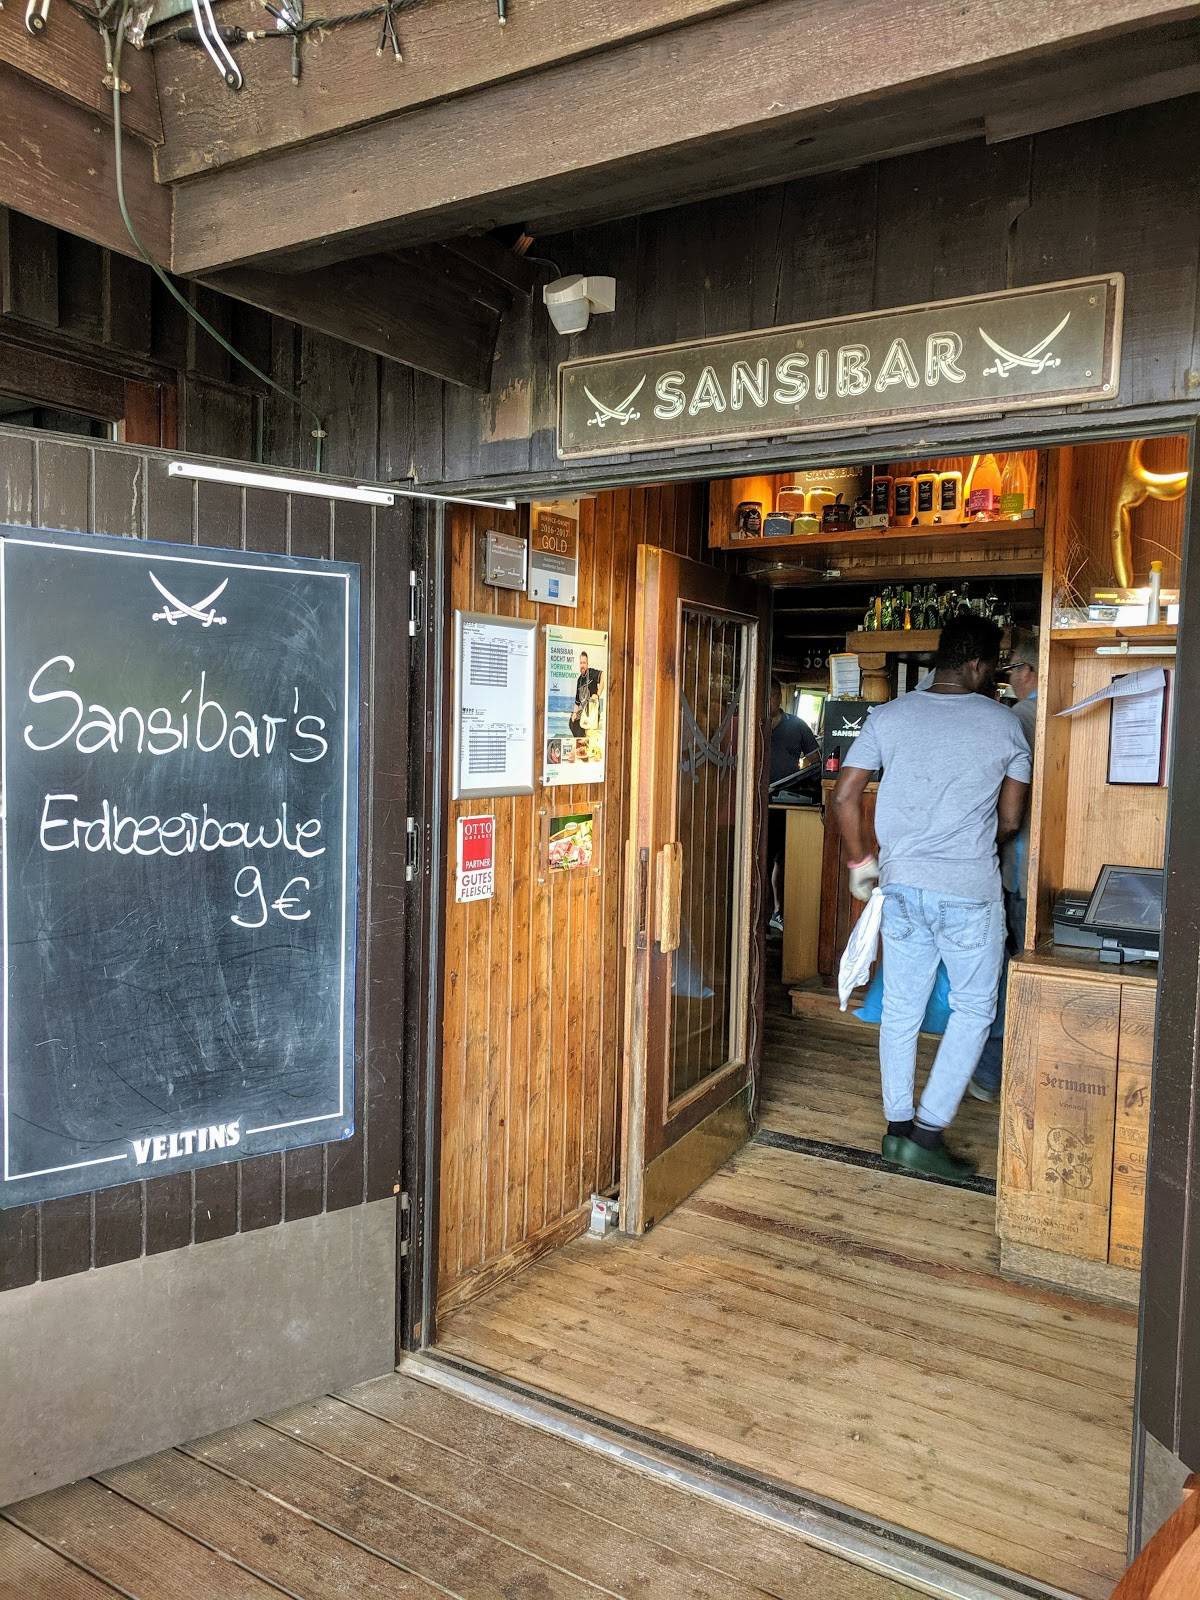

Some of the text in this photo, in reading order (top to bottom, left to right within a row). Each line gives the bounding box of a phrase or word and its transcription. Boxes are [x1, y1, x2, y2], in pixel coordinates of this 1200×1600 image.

[653, 330, 967, 420] SANSIBAR
[541, 534, 568, 553] GOLD
[550, 647, 574, 655] SANSIBAR
[24, 655, 328, 762] Sansibar's
[831, 729, 861, 737] SANSIB
[40, 793, 326, 858] Erdbeerbowle
[464, 822, 492, 836] OTTO
[465, 858, 491, 869] PARTNER
[461, 871, 492, 887] GUTES
[461, 884, 492, 898] FLEISCH
[132, 1120, 241, 1164] VELTINS
